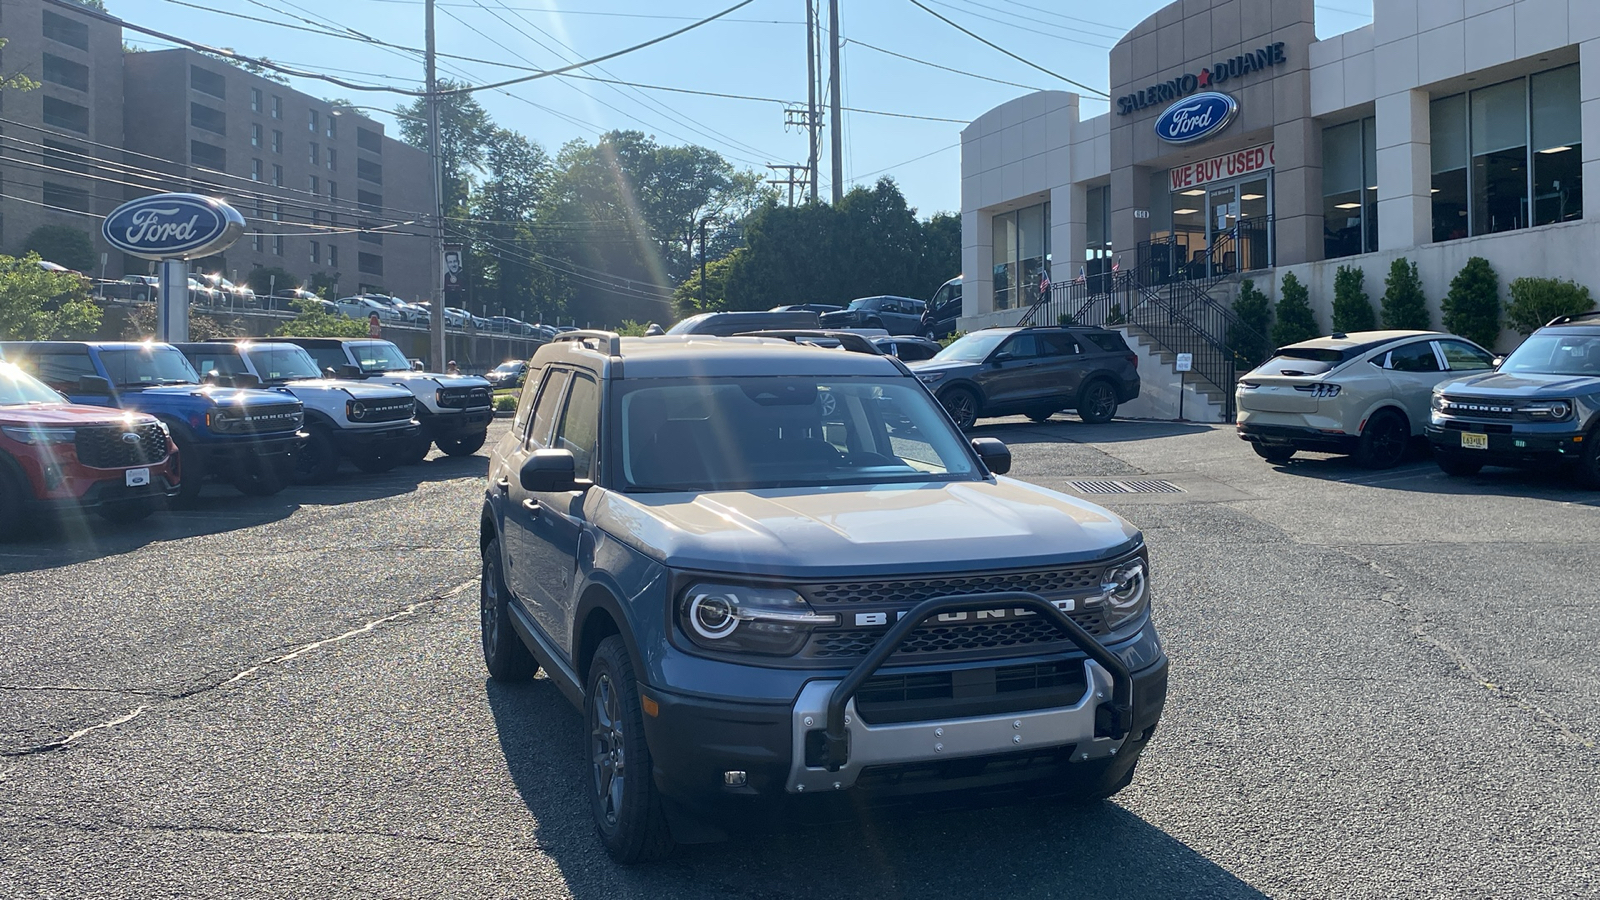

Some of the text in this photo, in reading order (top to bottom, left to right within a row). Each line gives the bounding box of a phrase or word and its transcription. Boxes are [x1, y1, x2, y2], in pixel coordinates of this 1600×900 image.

[1116, 41, 1287, 116] SALERNO DUANE
[1169, 103, 1213, 137] Ford
[1171, 165, 1192, 189] WE
[1196, 157, 1223, 184] BUY
[1227, 147, 1265, 176] USED
[125, 207, 199, 244] Ford
[244, 413, 291, 421] BRONCO
[1449, 402, 1512, 413] BRONCO
